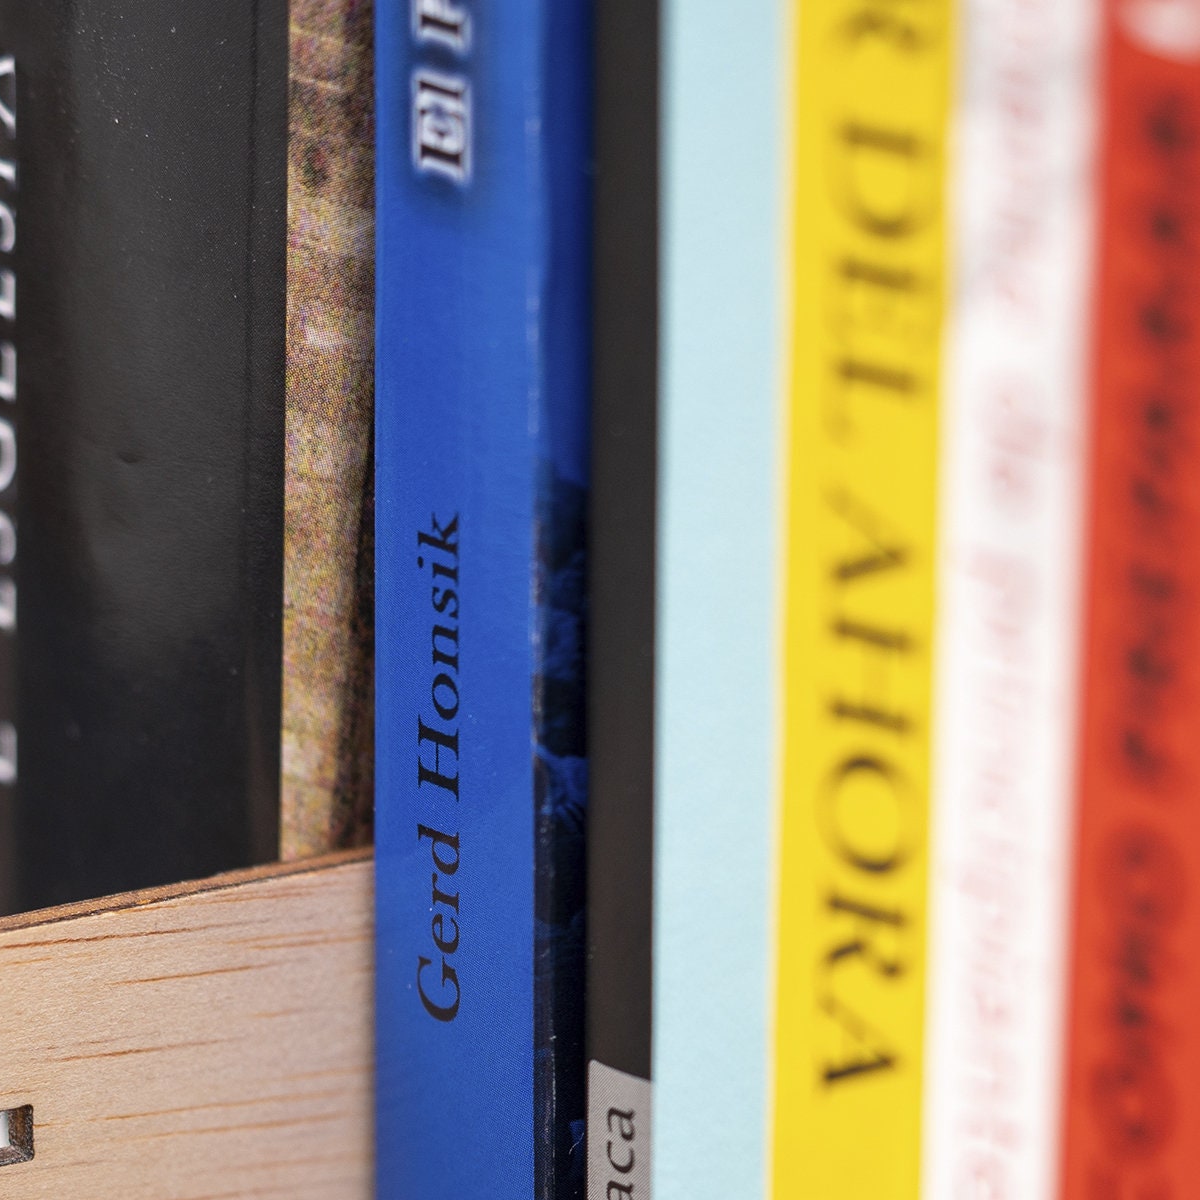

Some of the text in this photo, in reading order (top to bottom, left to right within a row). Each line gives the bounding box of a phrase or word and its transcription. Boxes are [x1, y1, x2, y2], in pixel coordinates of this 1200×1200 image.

[413, 70, 470, 183] El
[825, 115, 935, 443] DEL
[417, 512, 462, 1023] Gerd Honsik
[816, 480, 922, 1093] AHORA
